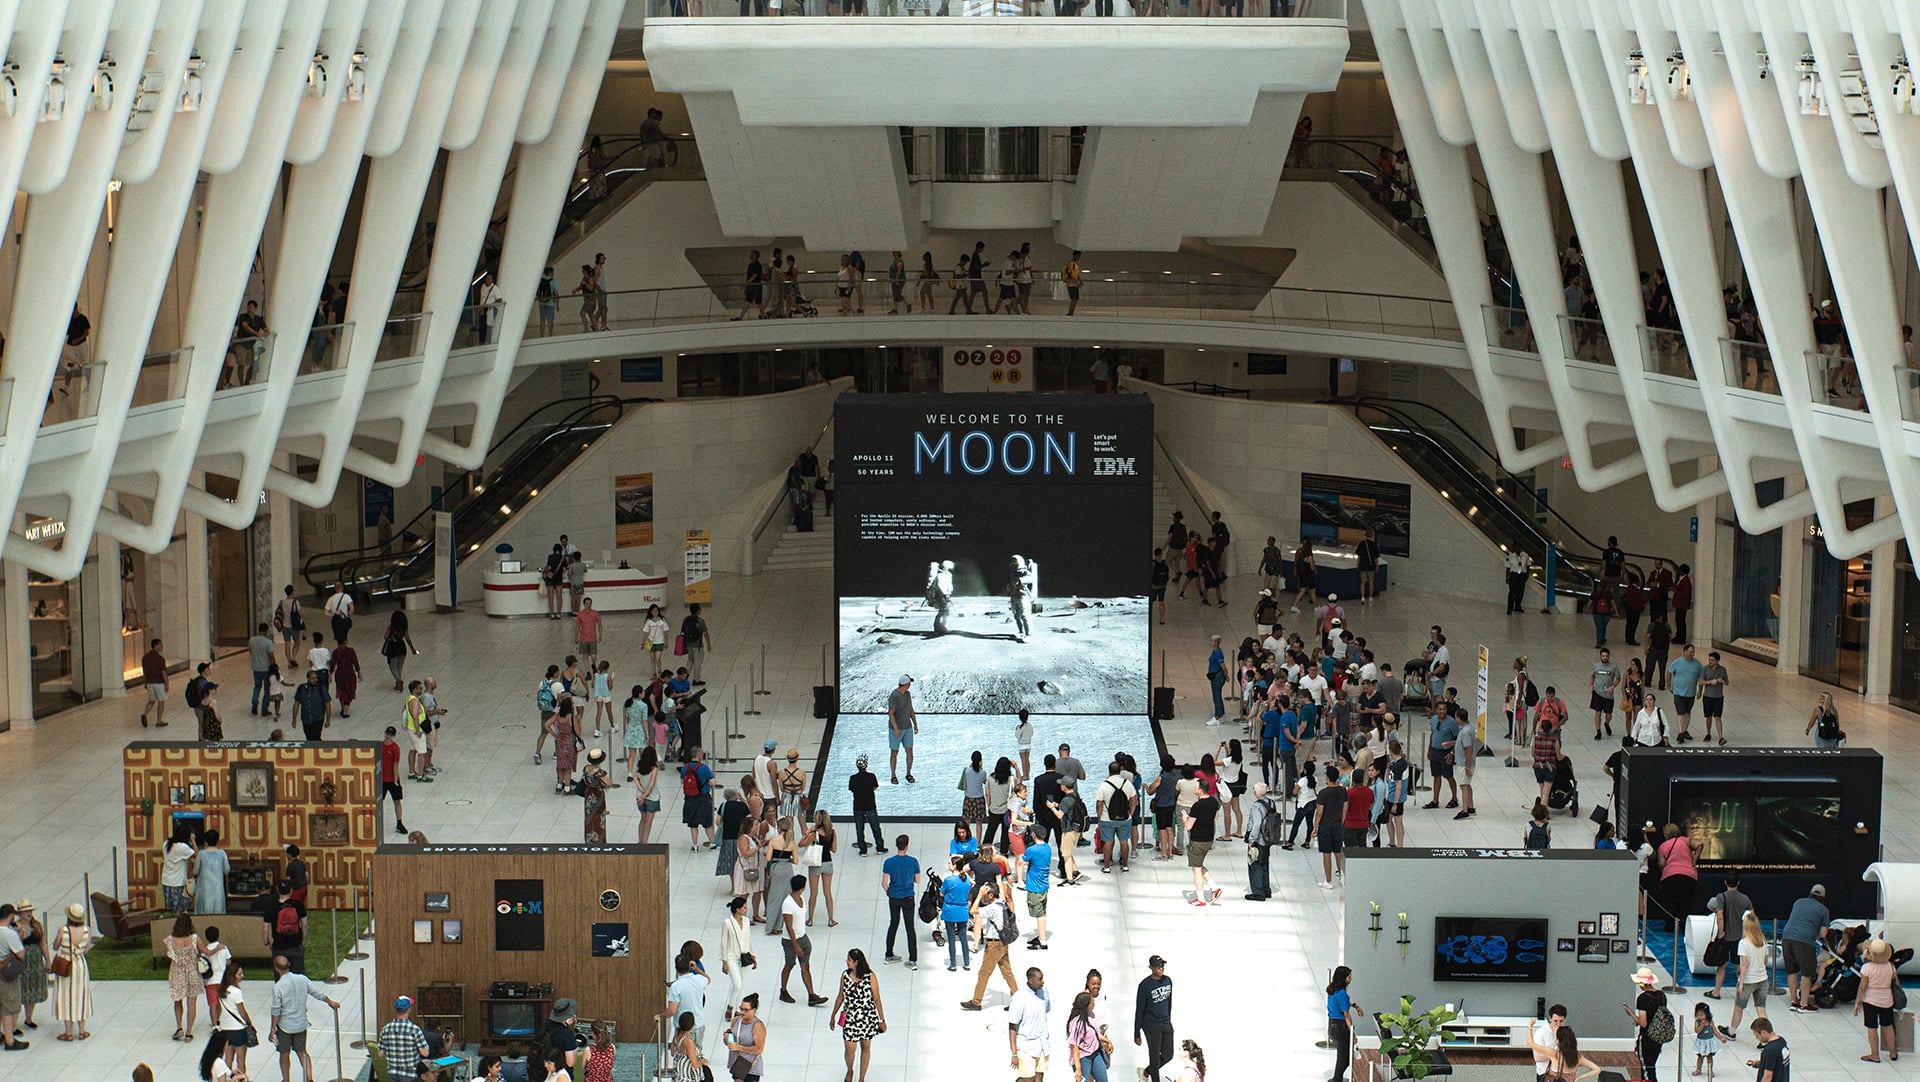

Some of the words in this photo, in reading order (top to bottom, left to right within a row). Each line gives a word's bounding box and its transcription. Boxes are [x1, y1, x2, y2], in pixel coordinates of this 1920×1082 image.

[926, 414, 1000, 424] WELCOME
[1009, 414, 1026, 424] TO
[1036, 414, 1064, 424] THE
[914, 430, 1076, 476] MOON
[1094, 458, 1136, 476] IBM
[1476, 849, 1544, 857] IBM
